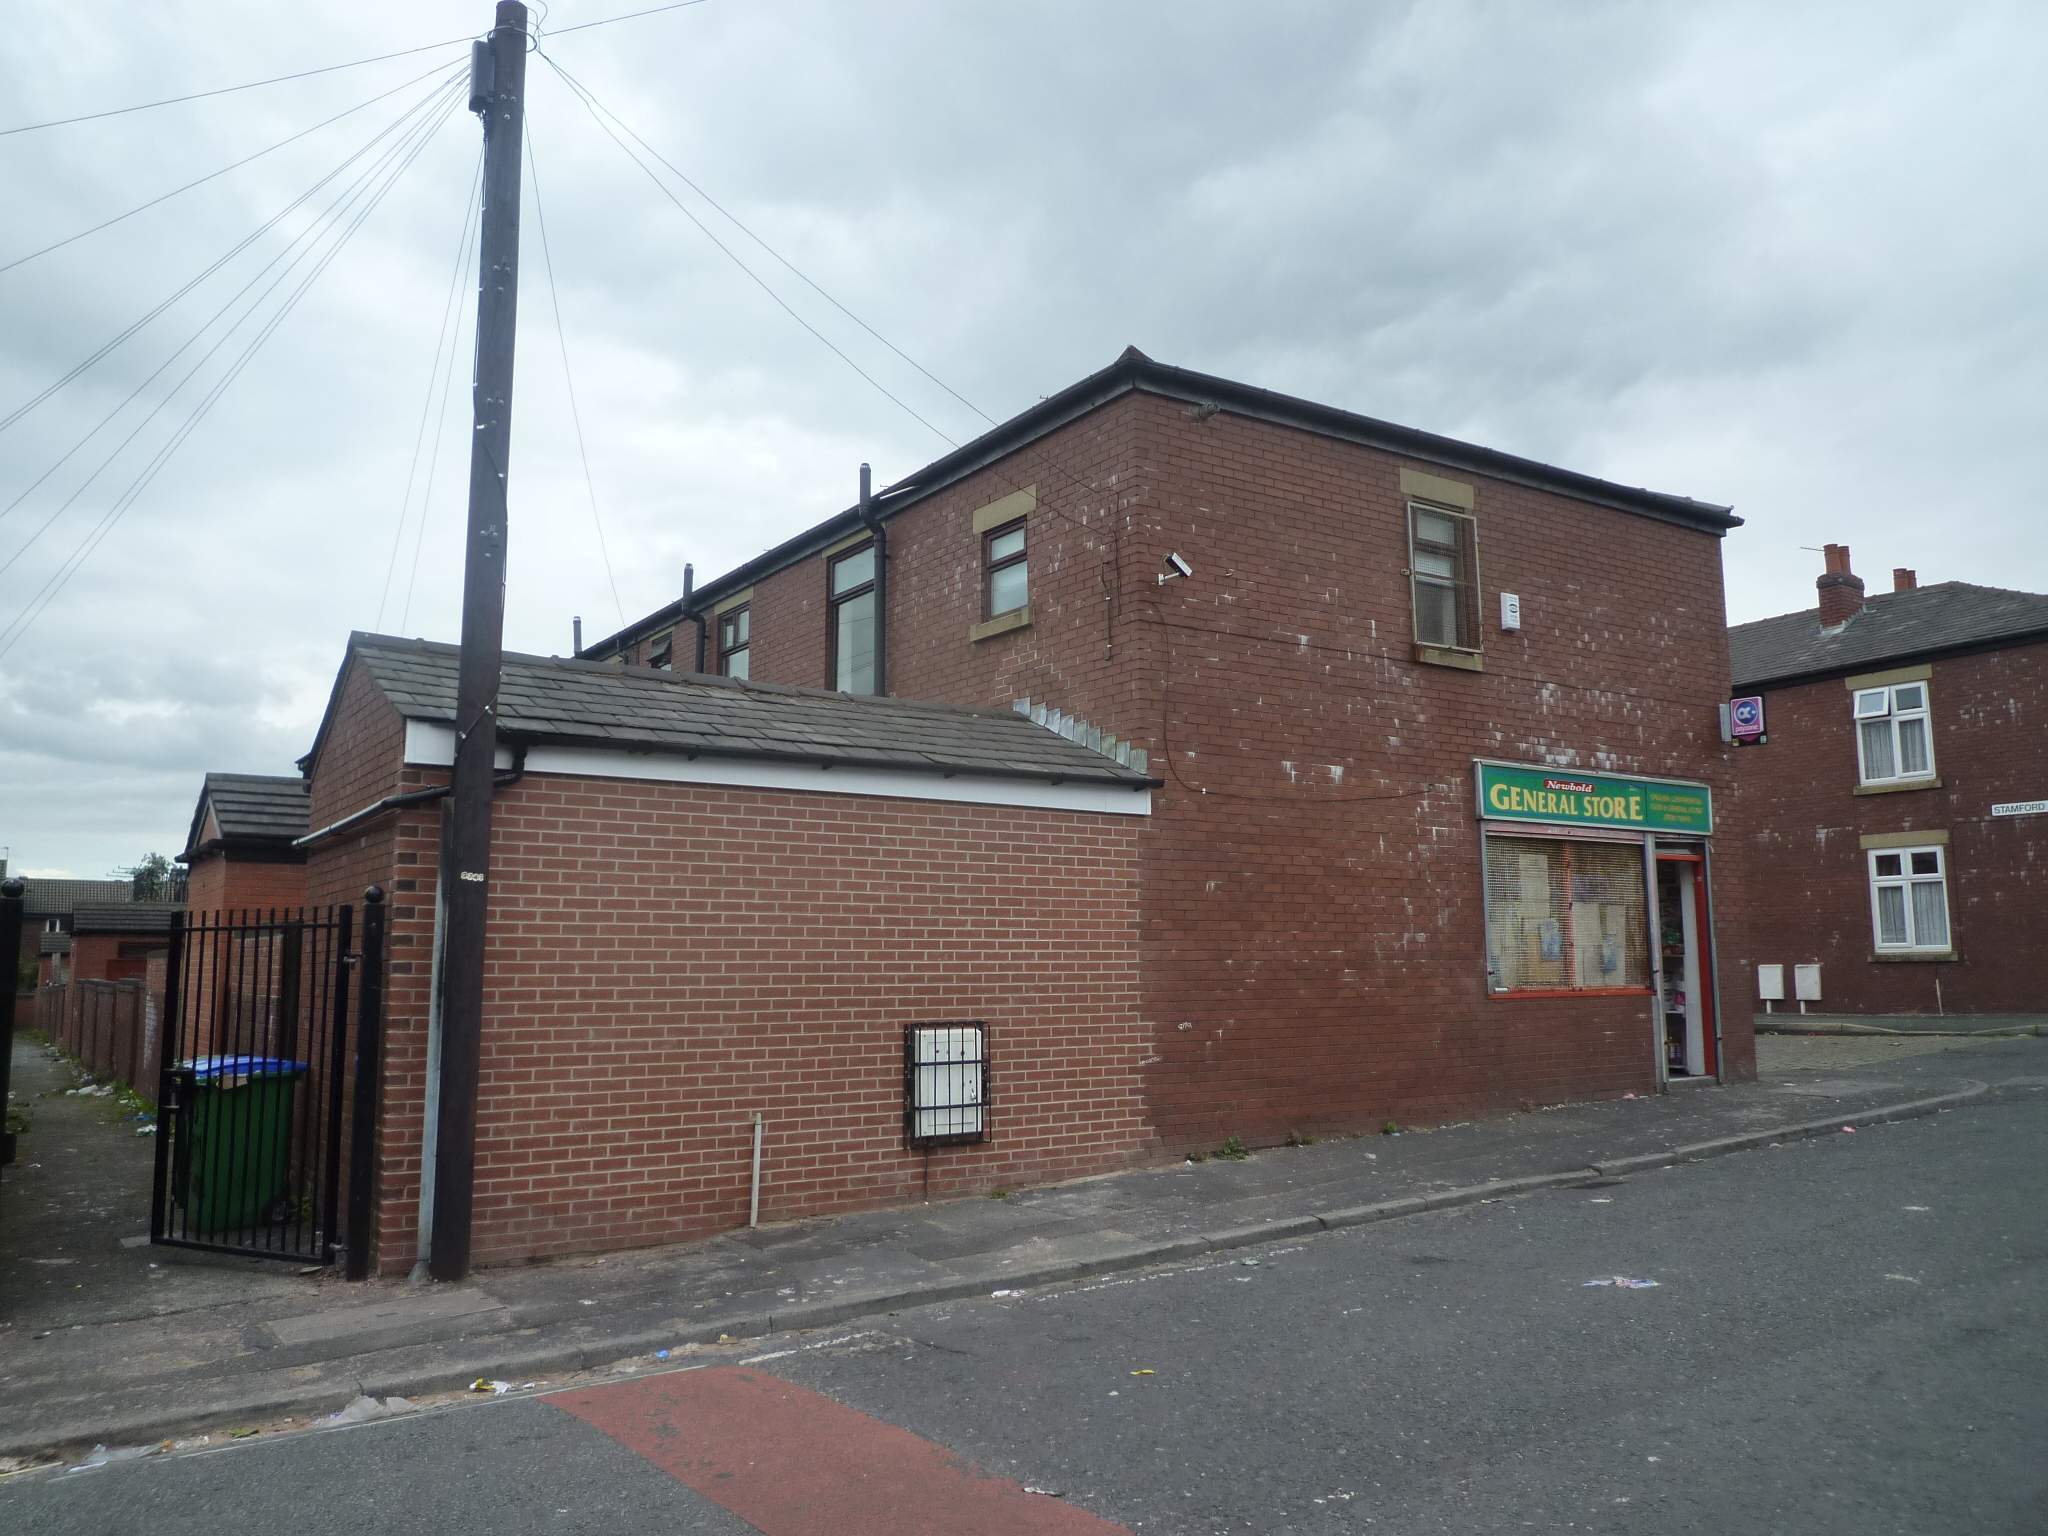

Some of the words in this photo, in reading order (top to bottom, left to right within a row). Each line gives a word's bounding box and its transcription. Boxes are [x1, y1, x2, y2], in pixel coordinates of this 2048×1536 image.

[1546, 780, 1593, 793] Newbold
[1490, 783, 1578, 815] GENERAL
[1583, 796, 1643, 820] STORE
[1994, 803, 2045, 814] STAMFORD
